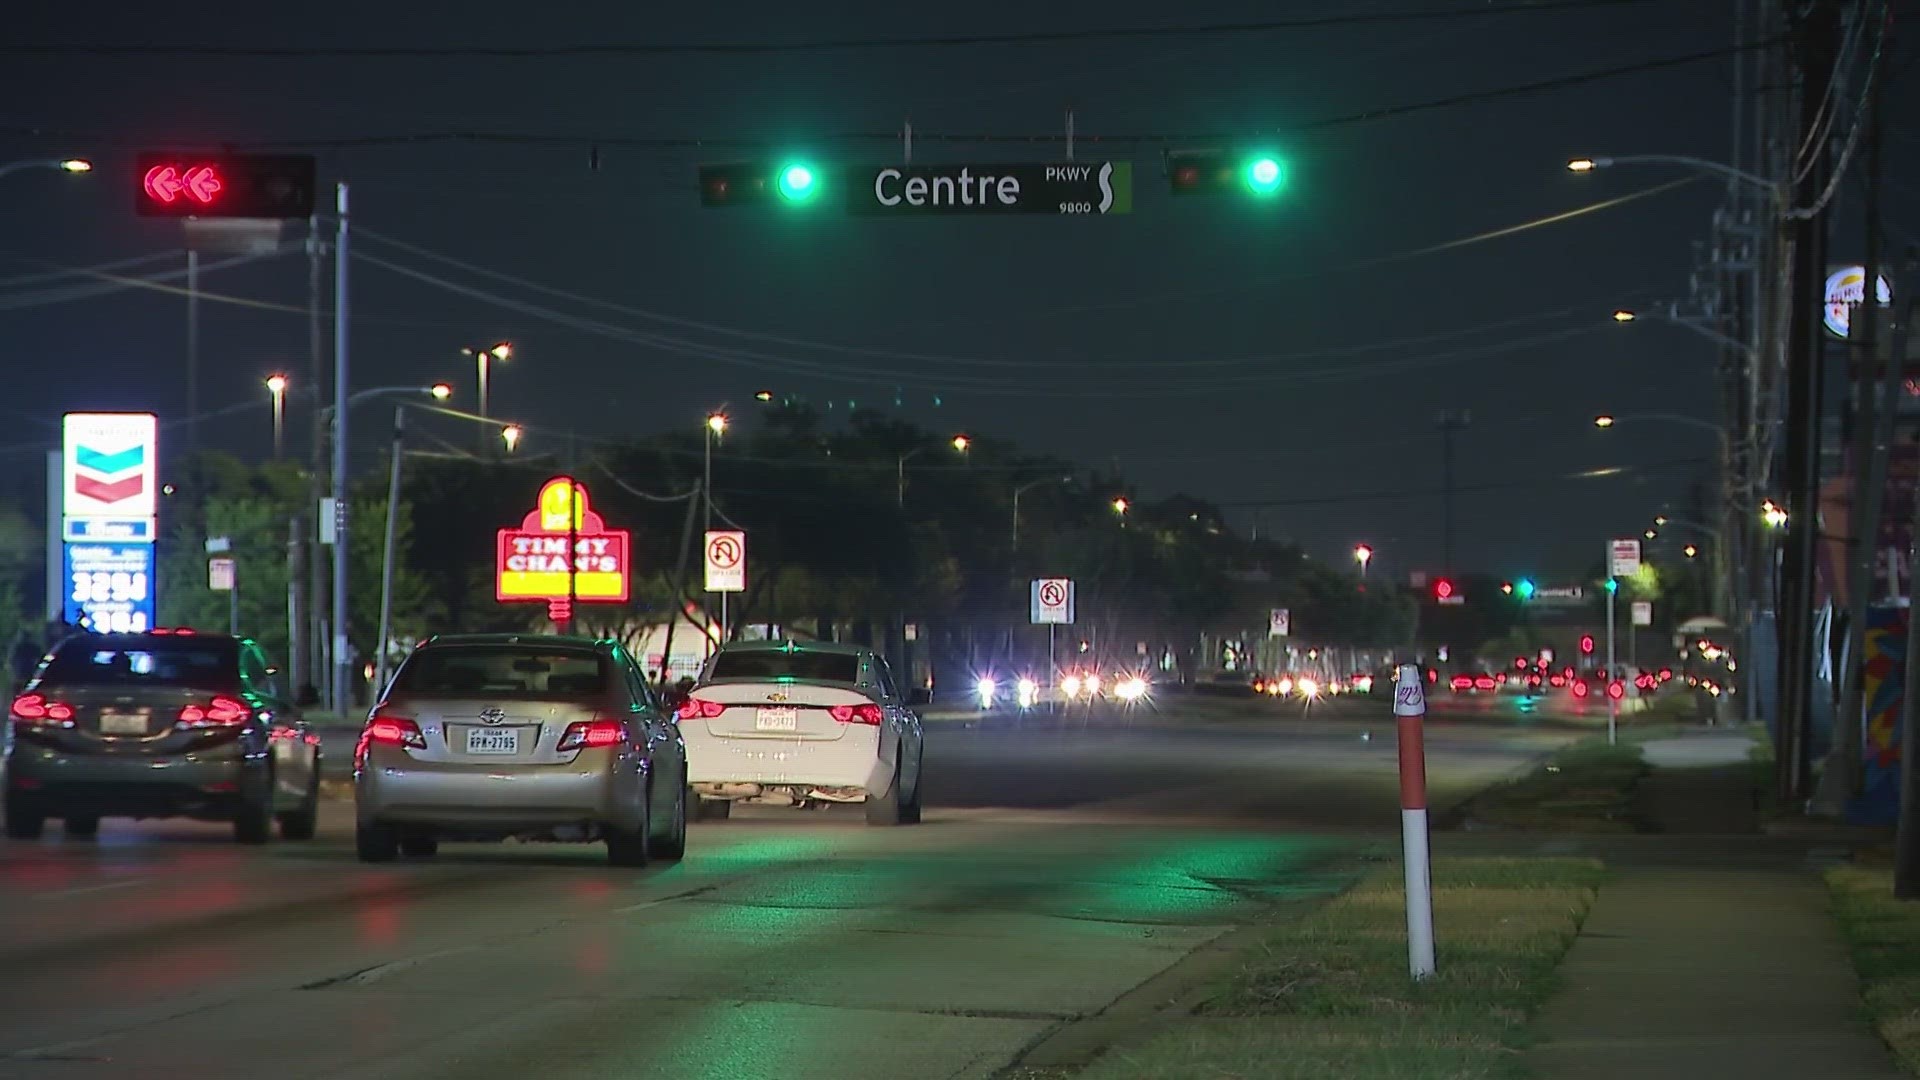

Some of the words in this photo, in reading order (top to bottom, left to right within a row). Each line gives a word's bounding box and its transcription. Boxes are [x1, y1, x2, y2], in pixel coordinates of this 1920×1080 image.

[1046, 167, 1091, 181] PKWY
[875, 167, 1020, 206] Centre
[1059, 202, 1091, 213] 9800
[511, 537, 610, 555] TIMMY
[506, 555, 617, 571] CHAN'S
